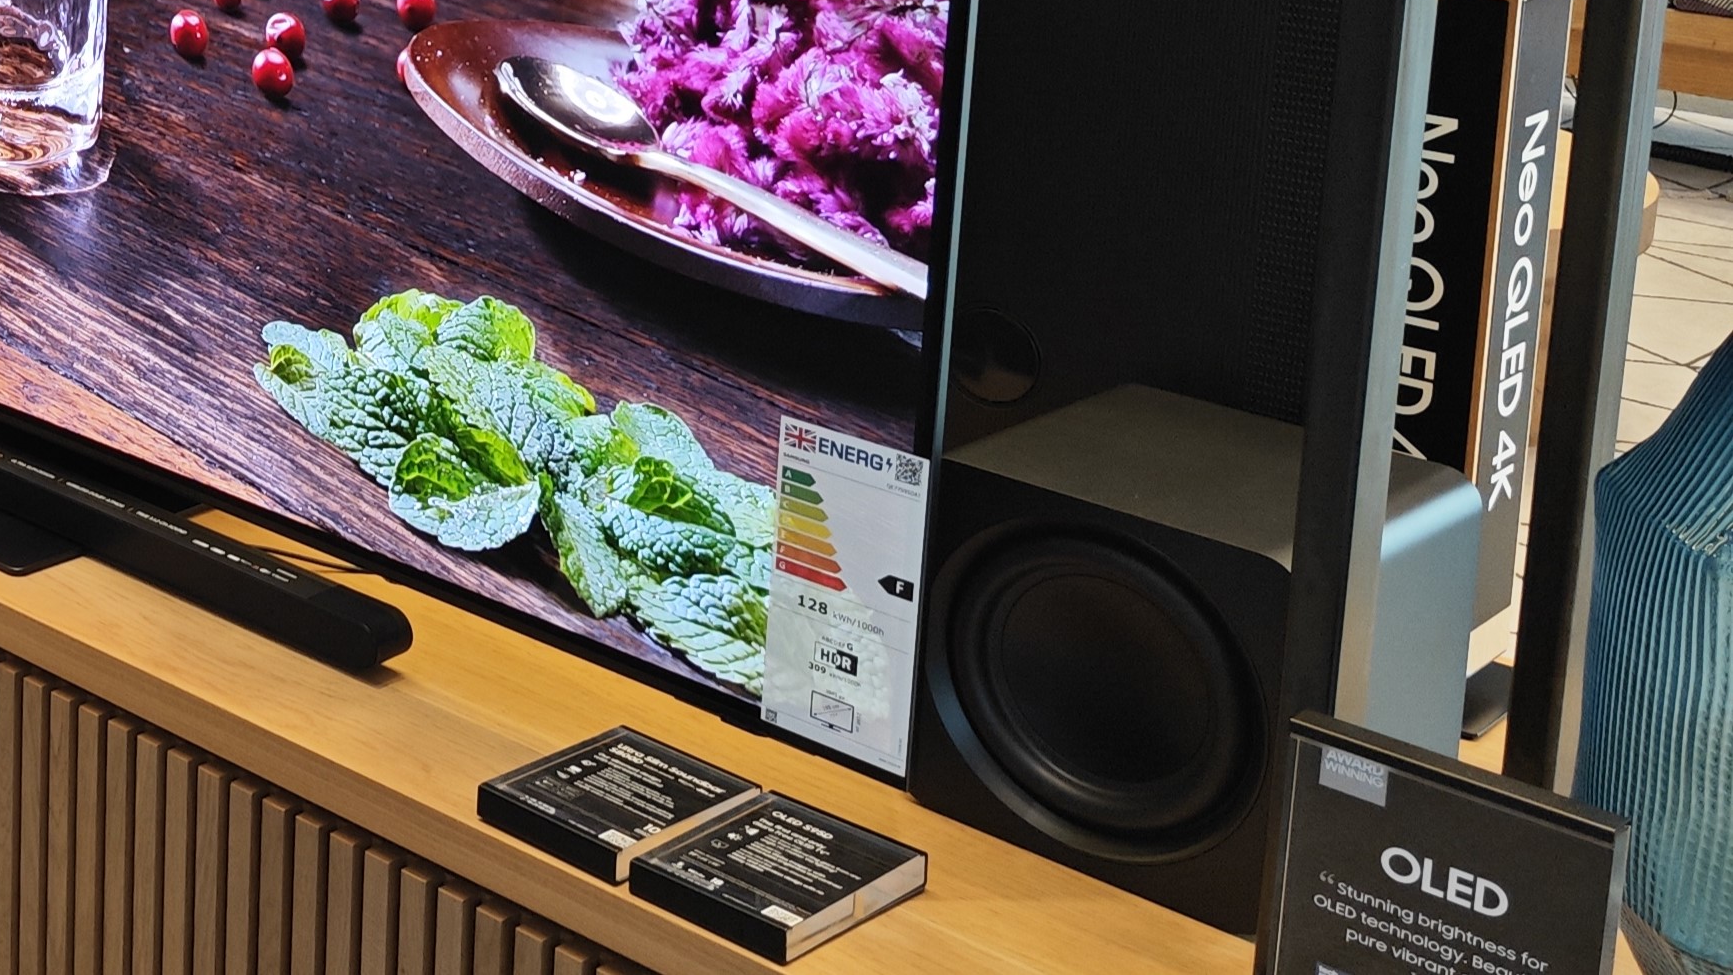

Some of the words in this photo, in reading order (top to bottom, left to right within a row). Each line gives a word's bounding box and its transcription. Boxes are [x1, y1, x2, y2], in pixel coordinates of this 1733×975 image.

[1514, 109, 1549, 247] Neo
[1497, 256, 1533, 418] QLED
[818, 437, 883, 471] ENERG
[784, 469, 792, 478] A
[1488, 429, 1517, 512] 4K
[782, 499, 789, 508] C
[784, 484, 791, 493] B
[780, 545, 785, 554] F
[778, 561, 786, 570] G
[895, 581, 904, 594] F
[797, 594, 828, 615] 128
[832, 611, 885, 637] kWh/1000h
[820, 647, 852, 671] HDR
[846, 643, 854, 651] G
[617, 743, 645, 758] Ultra
[644, 755, 669, 769] Slim
[668, 766, 727, 794] Soundbar
[1324, 758, 1384, 788] WINNING
[1326, 750, 1384, 776] AWARD
[771, 810, 803, 826] OLED
[802, 823, 834, 840] S95D
[1380, 846, 1509, 917] OLED
[1313, 894, 1357, 919] OLED
[1360, 911, 1468, 964] technology.
[1417, 912, 1517, 961] brightness
[1521, 951, 1548, 972] for
[1345, 928, 1387, 952] pure
[1392, 945, 1456, 975] vibrant
